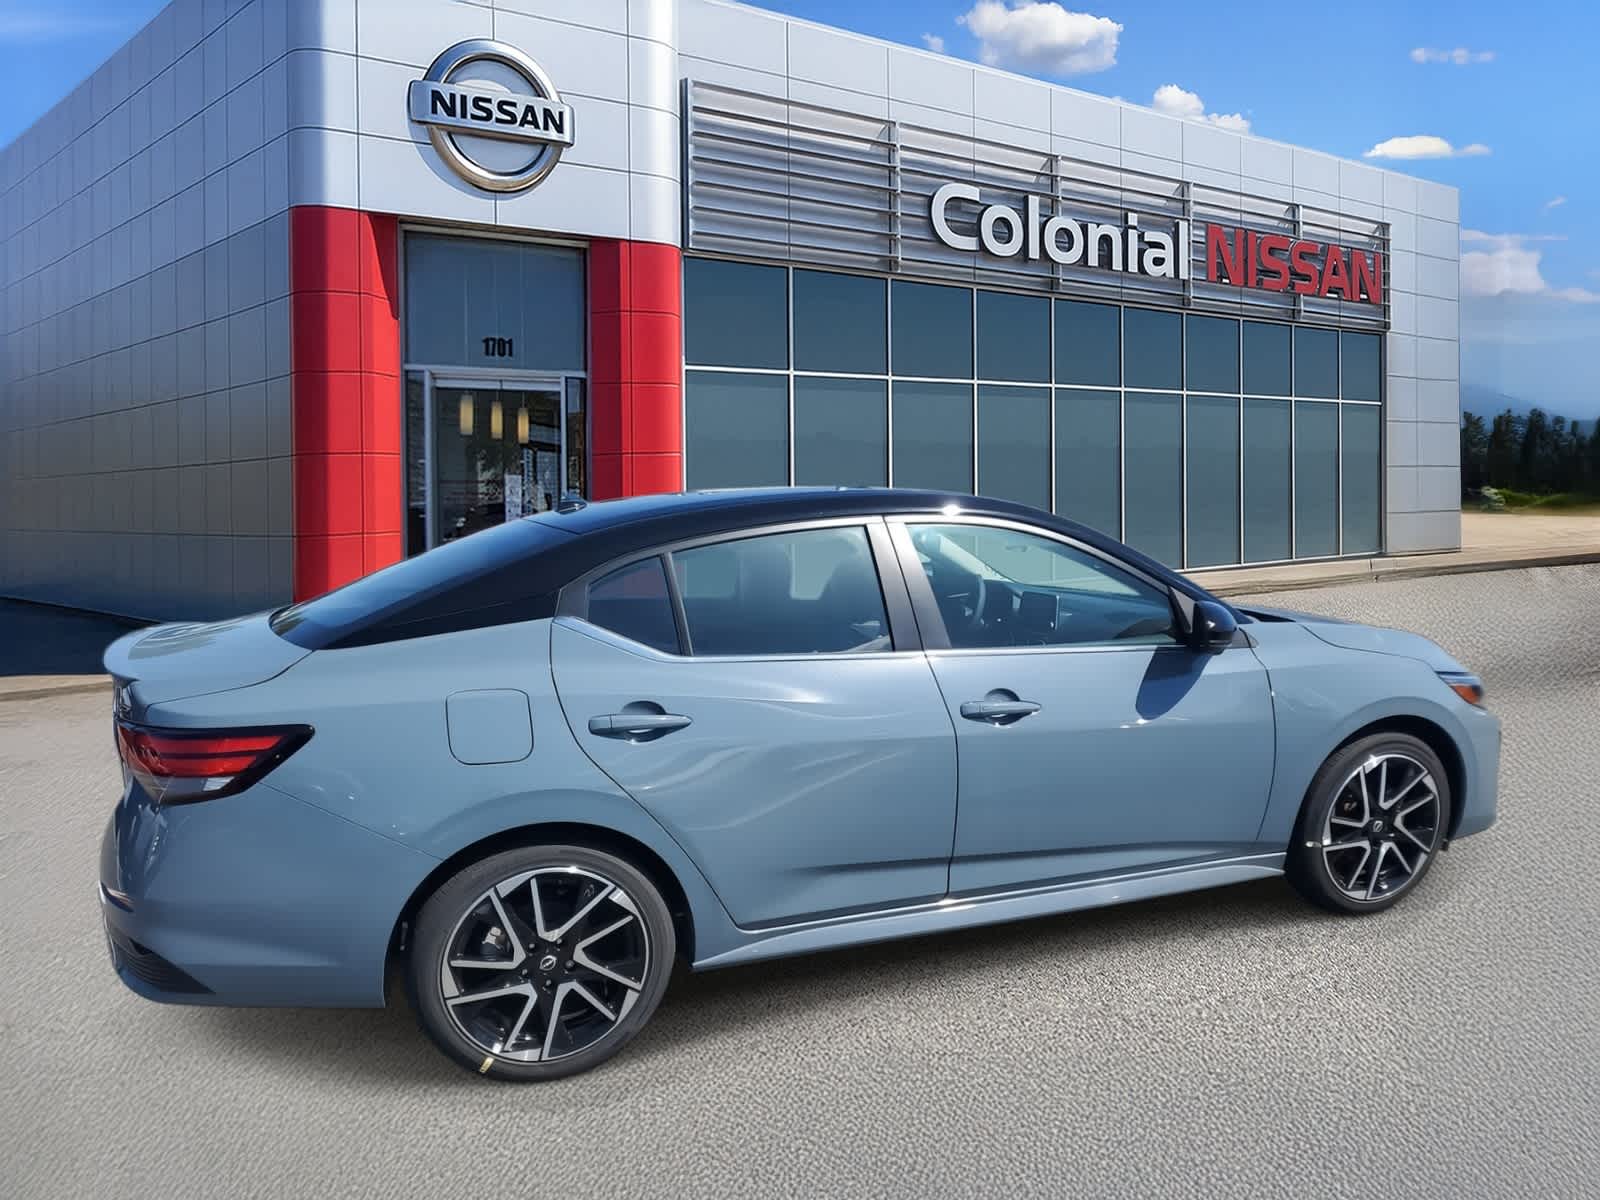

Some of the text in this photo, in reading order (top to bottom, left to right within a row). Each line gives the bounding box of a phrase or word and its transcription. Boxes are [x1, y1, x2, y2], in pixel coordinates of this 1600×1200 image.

[431, 89, 564, 134] NISSAN
[931, 183, 1381, 305] Colonial NISSAN
[482, 336, 513, 358] 1701
